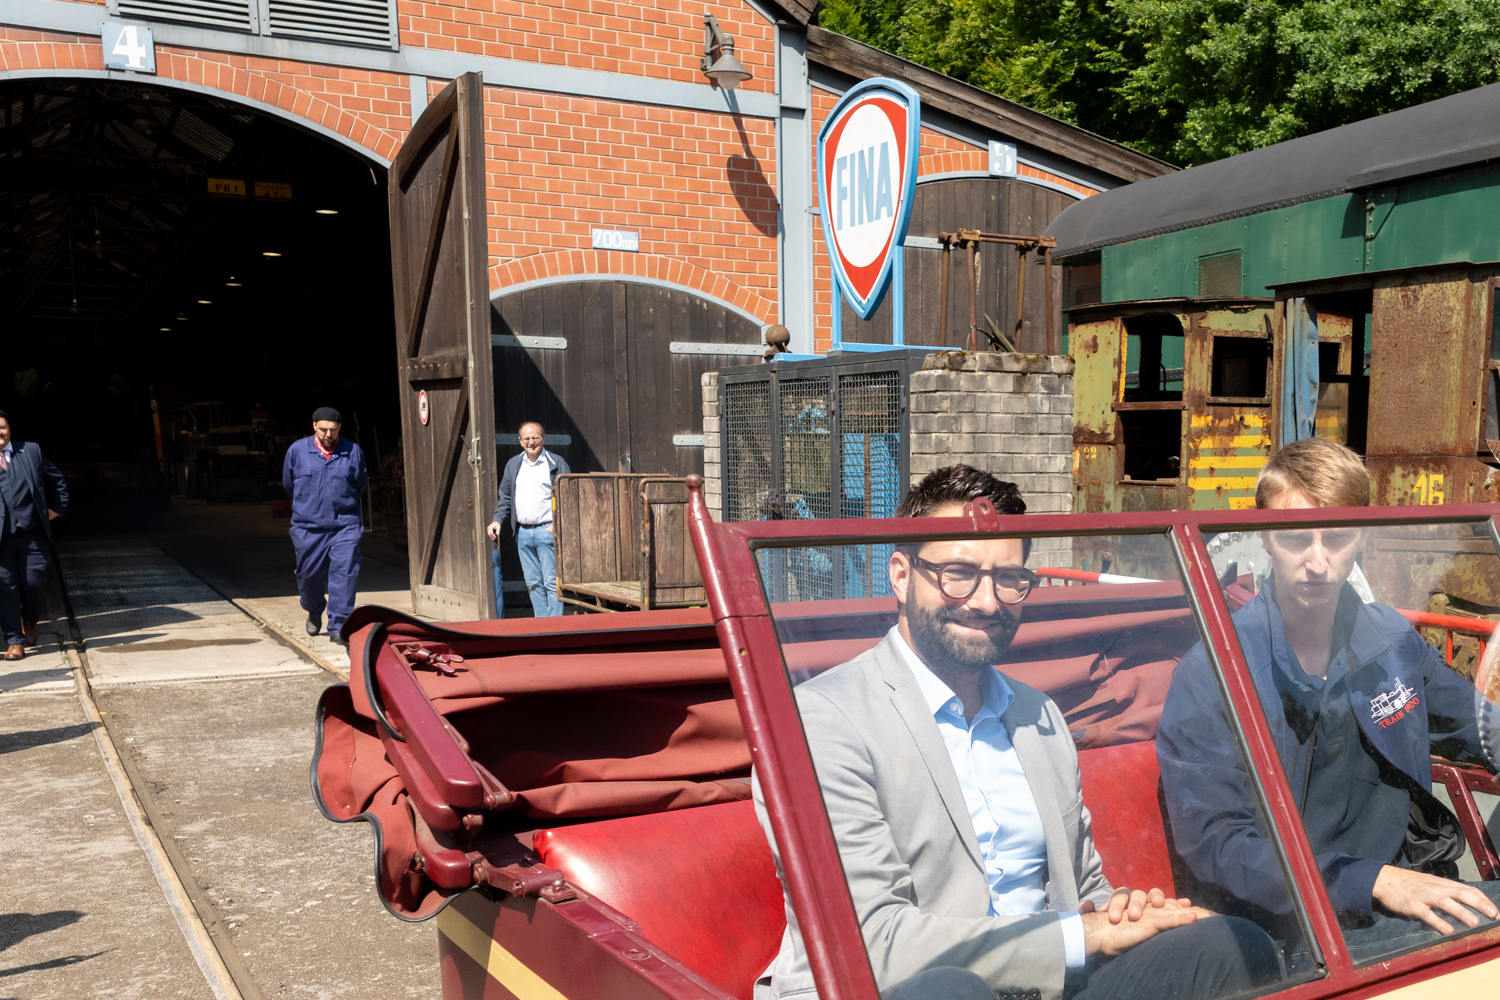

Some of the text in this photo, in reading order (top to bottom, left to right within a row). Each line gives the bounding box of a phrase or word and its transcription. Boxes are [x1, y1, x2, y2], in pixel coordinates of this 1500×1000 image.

[112, 25, 146, 69] 4
[994, 143, 1012, 174] 5
[836, 141, 894, 231] FINA
[1412, 474, 1444, 506] 16
[1378, 710, 1405, 729] TRAIN
